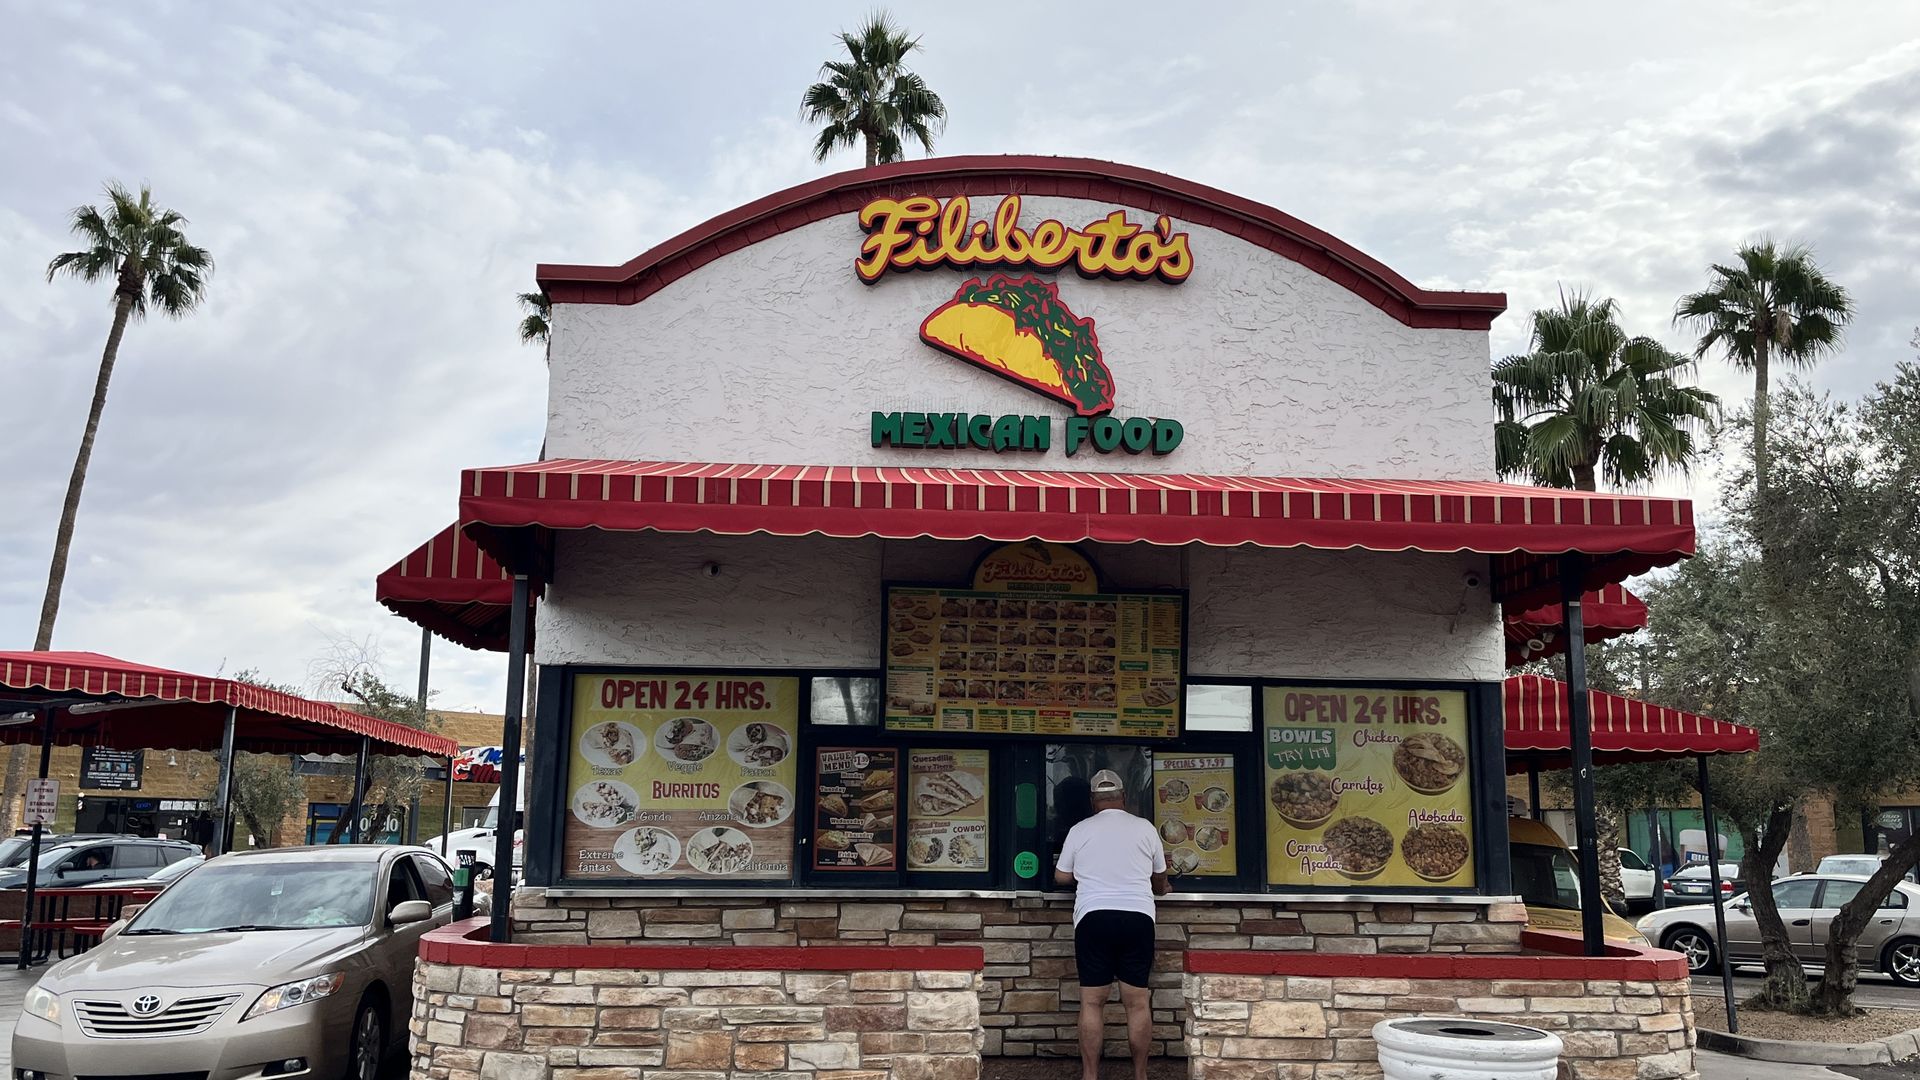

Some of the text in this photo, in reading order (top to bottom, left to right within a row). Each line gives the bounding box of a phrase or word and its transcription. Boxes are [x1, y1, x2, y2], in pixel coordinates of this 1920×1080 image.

[855, 194, 1194, 284] Filiberto's
[871, 412, 1184, 457] MEXICAN FOOD
[601, 679, 771, 709] OPEN 24 HRS.
[1284, 693, 1447, 725] OPEN 24 HRS.
[1269, 729, 1332, 744] BOWLS
[1353, 729, 1402, 747] Chicken
[822, 752, 852, 761] VALUE
[1274, 749, 1303, 762] TRY
[592, 765, 623, 776] Texas
[667, 761, 703, 775] Veggie
[824, 762, 850, 770] MENU
[1163, 760, 1195, 769] SPECIALS
[652, 780, 720, 799] BURRITOS
[1330, 776, 1384, 796] Carnitas
[639, 812, 672, 821] Gordo
[1408, 809, 1465, 829] Adobada
[953, 825, 985, 833] COWBOY
[578, 850, 624, 860] Extreme
[1286, 840, 1327, 857] Carne
[1301, 856, 1342, 875] Asada
